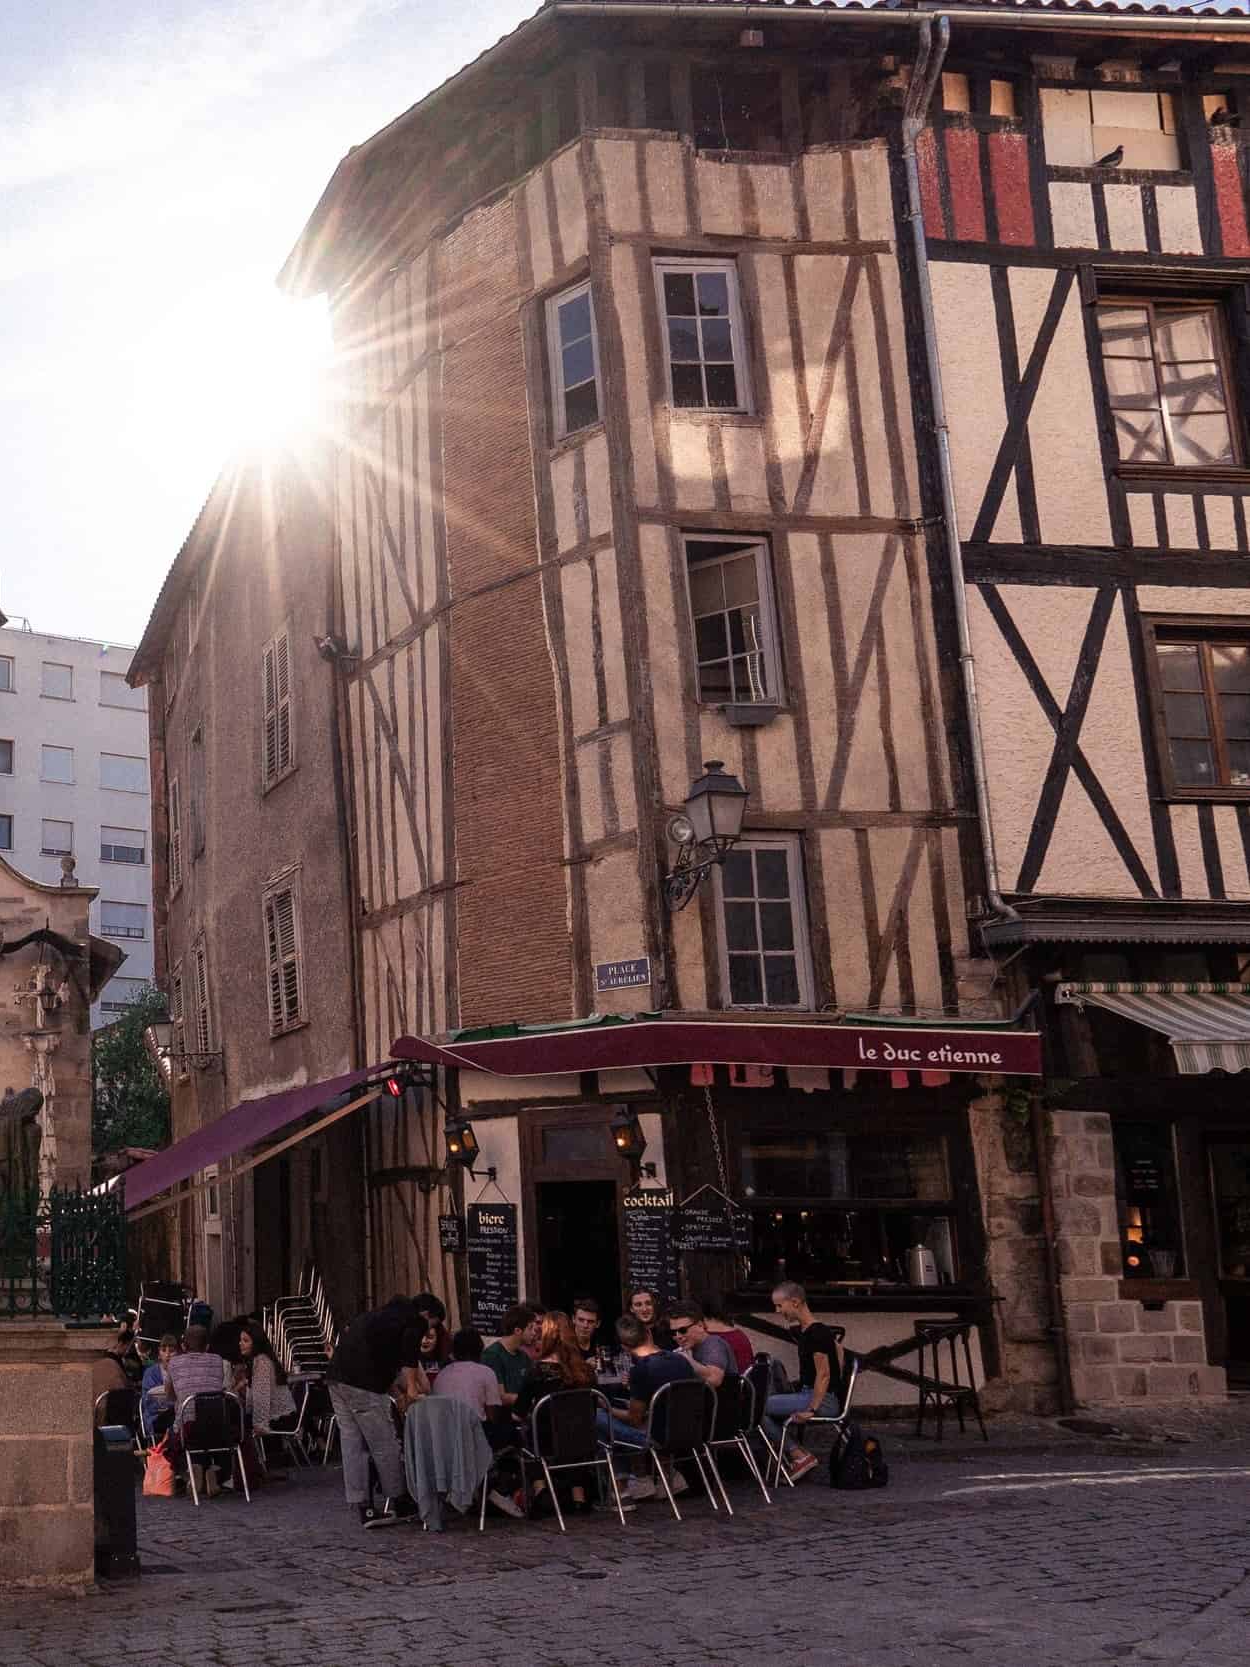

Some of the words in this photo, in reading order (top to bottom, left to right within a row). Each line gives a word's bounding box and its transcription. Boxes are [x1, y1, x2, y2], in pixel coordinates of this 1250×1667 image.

[608, 963, 637, 976] PLACE
[858, 1037, 878, 1060] le
[883, 1042, 921, 1061] duc
[927, 1044, 1002, 1064] etienne
[623, 1192, 674, 1207] cocktail
